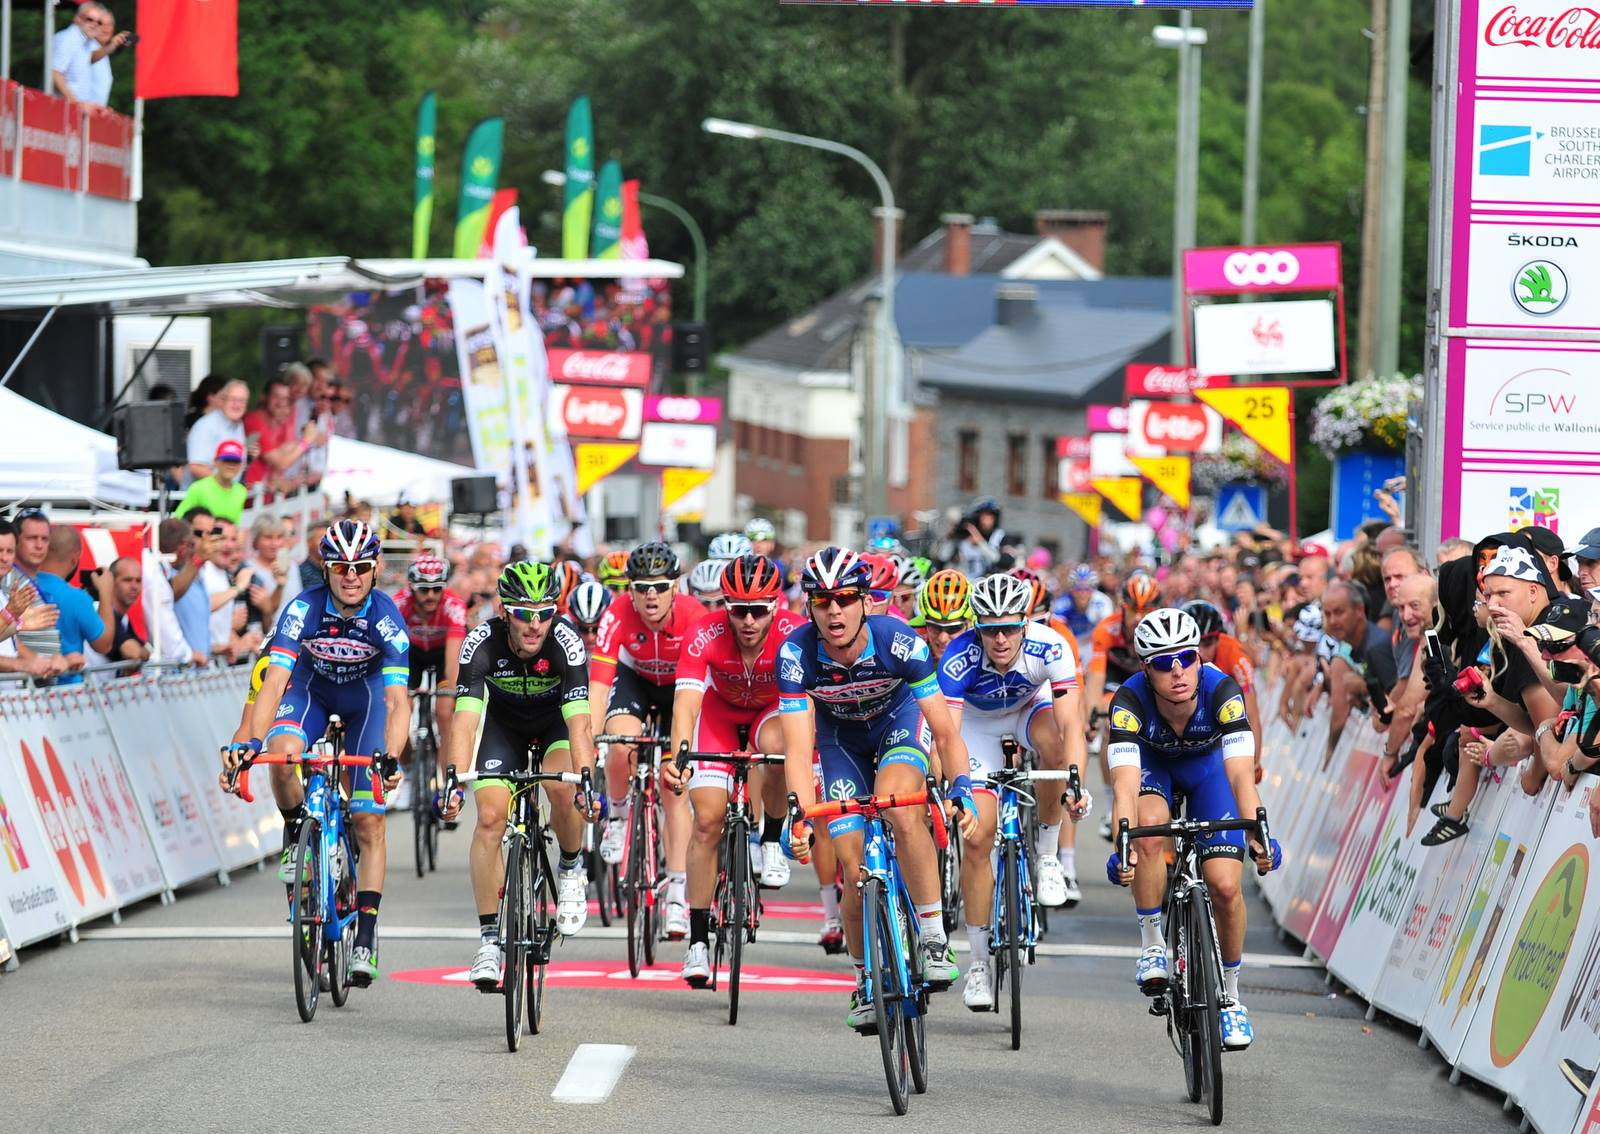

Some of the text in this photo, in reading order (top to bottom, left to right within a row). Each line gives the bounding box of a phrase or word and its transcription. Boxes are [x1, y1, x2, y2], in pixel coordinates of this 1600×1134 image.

[1559, 140, 1600, 151] SOUTH
[1553, 168, 1600, 179] AIRPOR
[1508, 233, 1578, 248] ŠKODA
[1245, 397, 1274, 419] 25
[1505, 393, 1576, 414] SPW
[1470, 421, 1504, 431] Service
[1506, 421, 1535, 432] public
[1538, 422, 1550, 432] de
[555, 628, 579, 662] MALO
[687, 622, 725, 658] Cofidis
[890, 641, 913, 663] DEV
